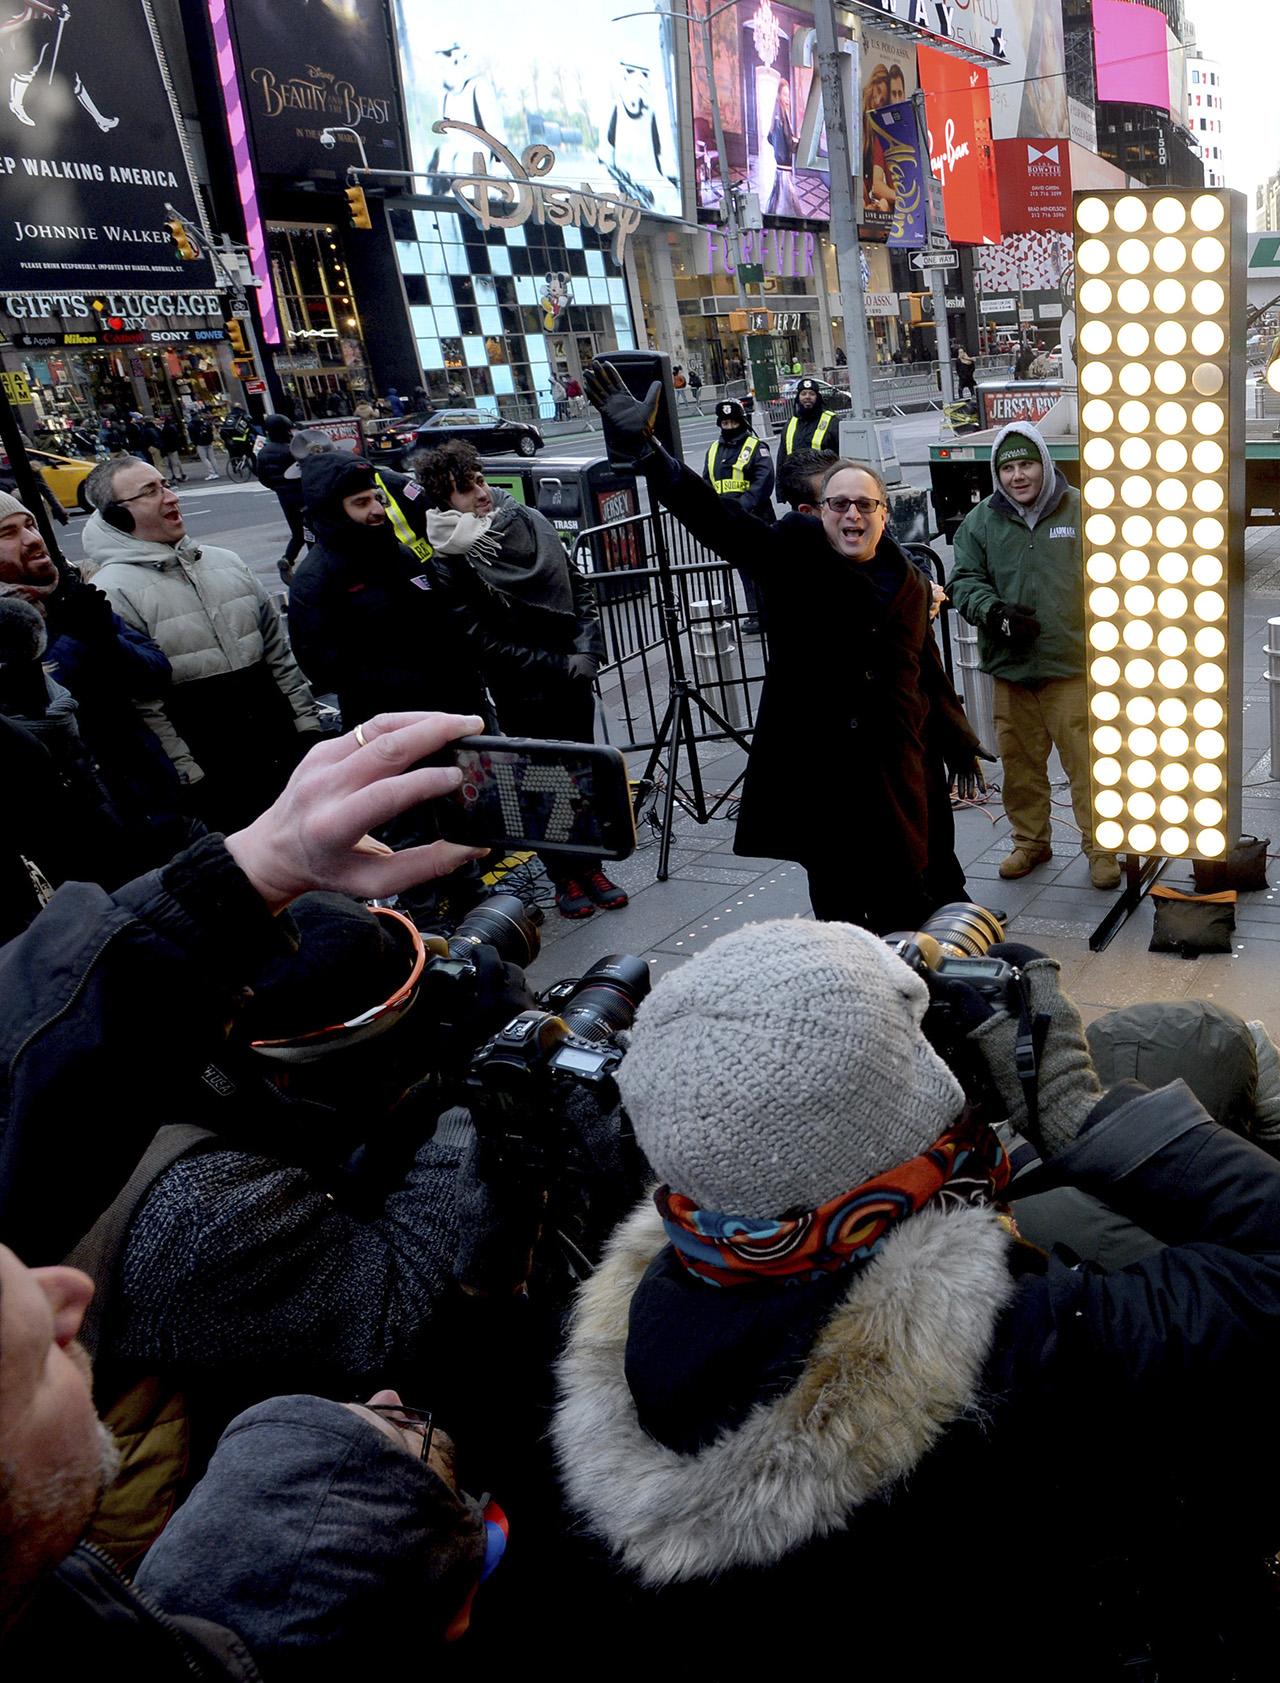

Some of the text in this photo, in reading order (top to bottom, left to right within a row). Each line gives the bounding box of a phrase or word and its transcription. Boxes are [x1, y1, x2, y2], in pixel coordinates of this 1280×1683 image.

[251, 67, 328, 117] BEAUTY
[334, 81, 391, 128] BEAST
[1158, 129, 1166, 165] 1500
[21, 157, 104, 182] WALKING
[110, 166, 178, 188] AMERICA
[14, 221, 171, 244] JOHNNIE WALKER
[98, 263, 124, 271] IMPORTED
[923, 254, 953, 264] ONE WAY
[6, 295, 222, 319] GIFTS LUGGAGE
[872, 296, 892, 307] ASSN.
[791, 314, 801, 330] 21
[33, 330, 225, 346] Apple Nikon Canon SONY BOWER
[14, 374, 28, 400] ATM
[990, 397, 1033, 419] JERSEY
[602, 491, 630, 521] JERSEY
[553, 519, 578, 531] TRASH
